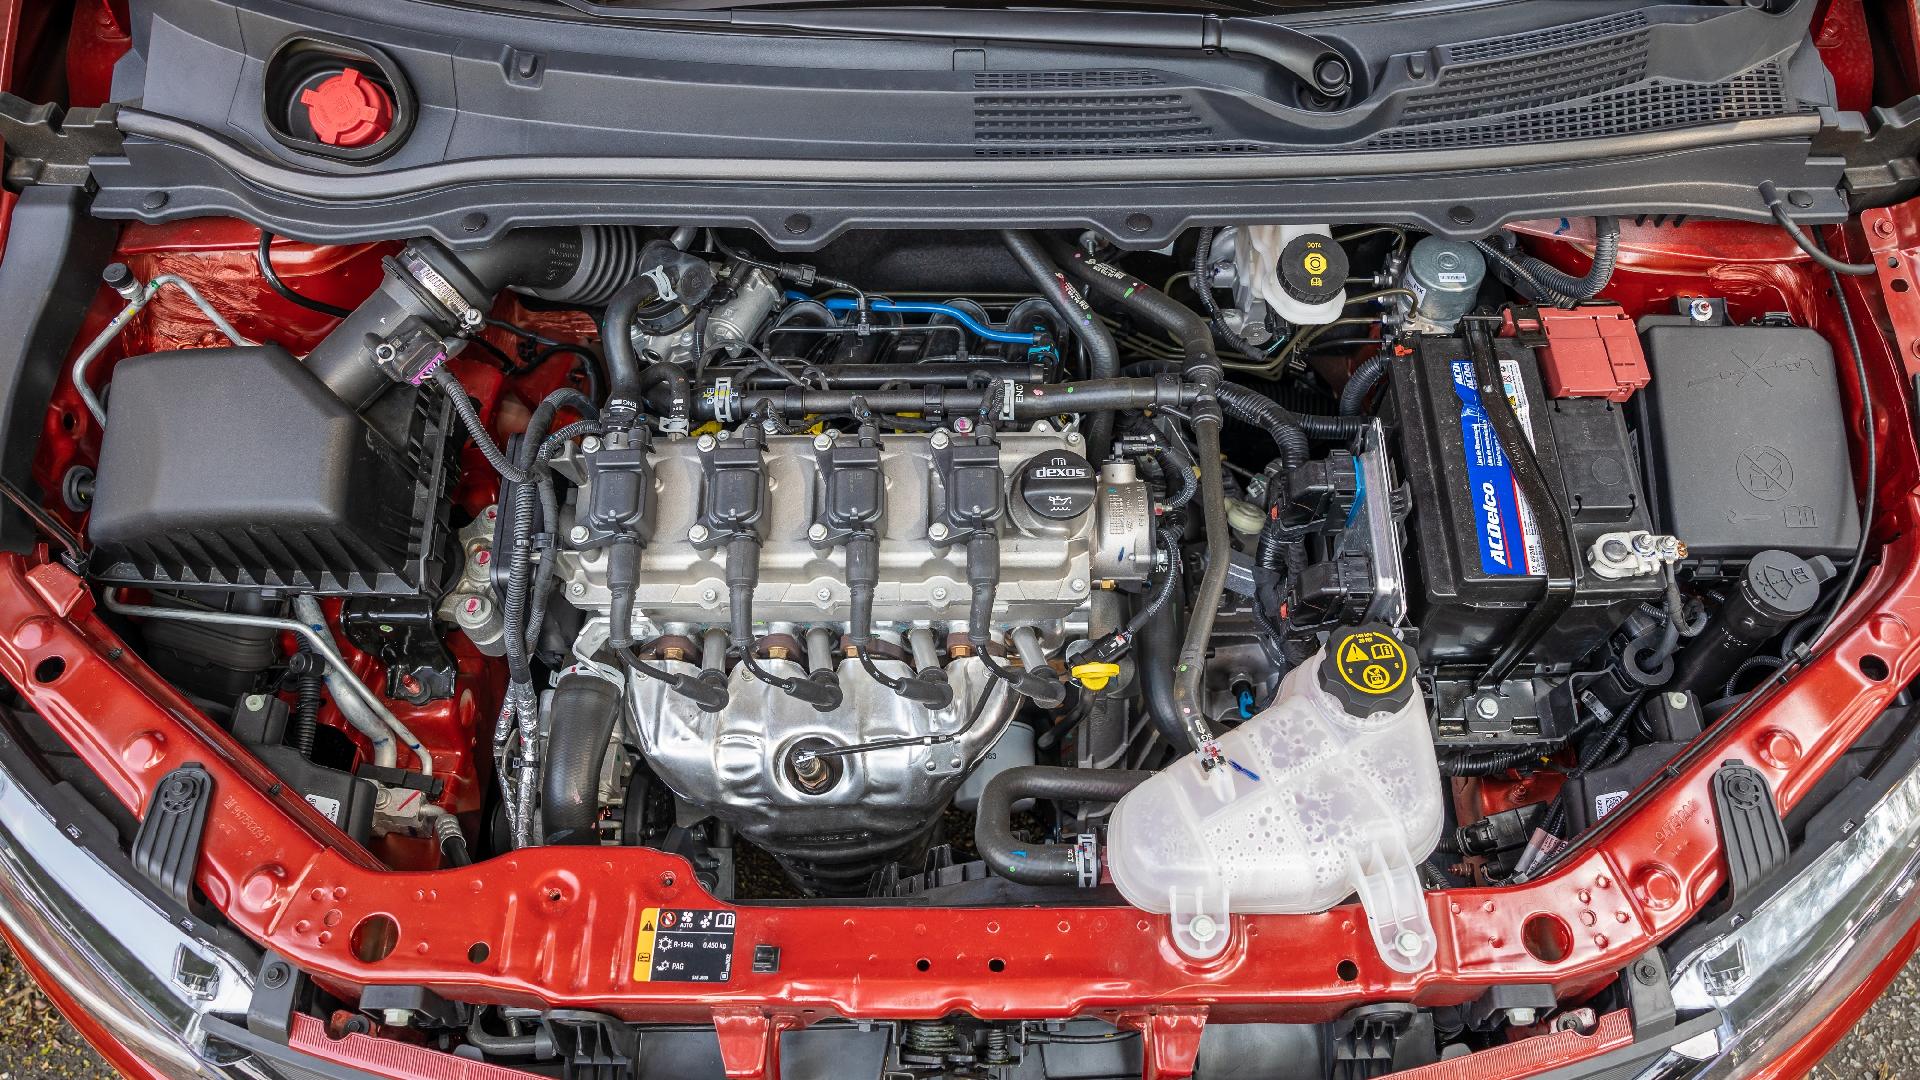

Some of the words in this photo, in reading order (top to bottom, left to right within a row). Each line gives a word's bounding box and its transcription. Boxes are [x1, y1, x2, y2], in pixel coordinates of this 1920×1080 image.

[1016, 384, 1024, 403] ENG
[622, 399, 637, 409] ENG
[1036, 467, 1085, 478] dexos
[1482, 482, 1506, 566] ACDelco
[673, 941, 694, 949] R-134a
[719, 941, 727, 950] kg
